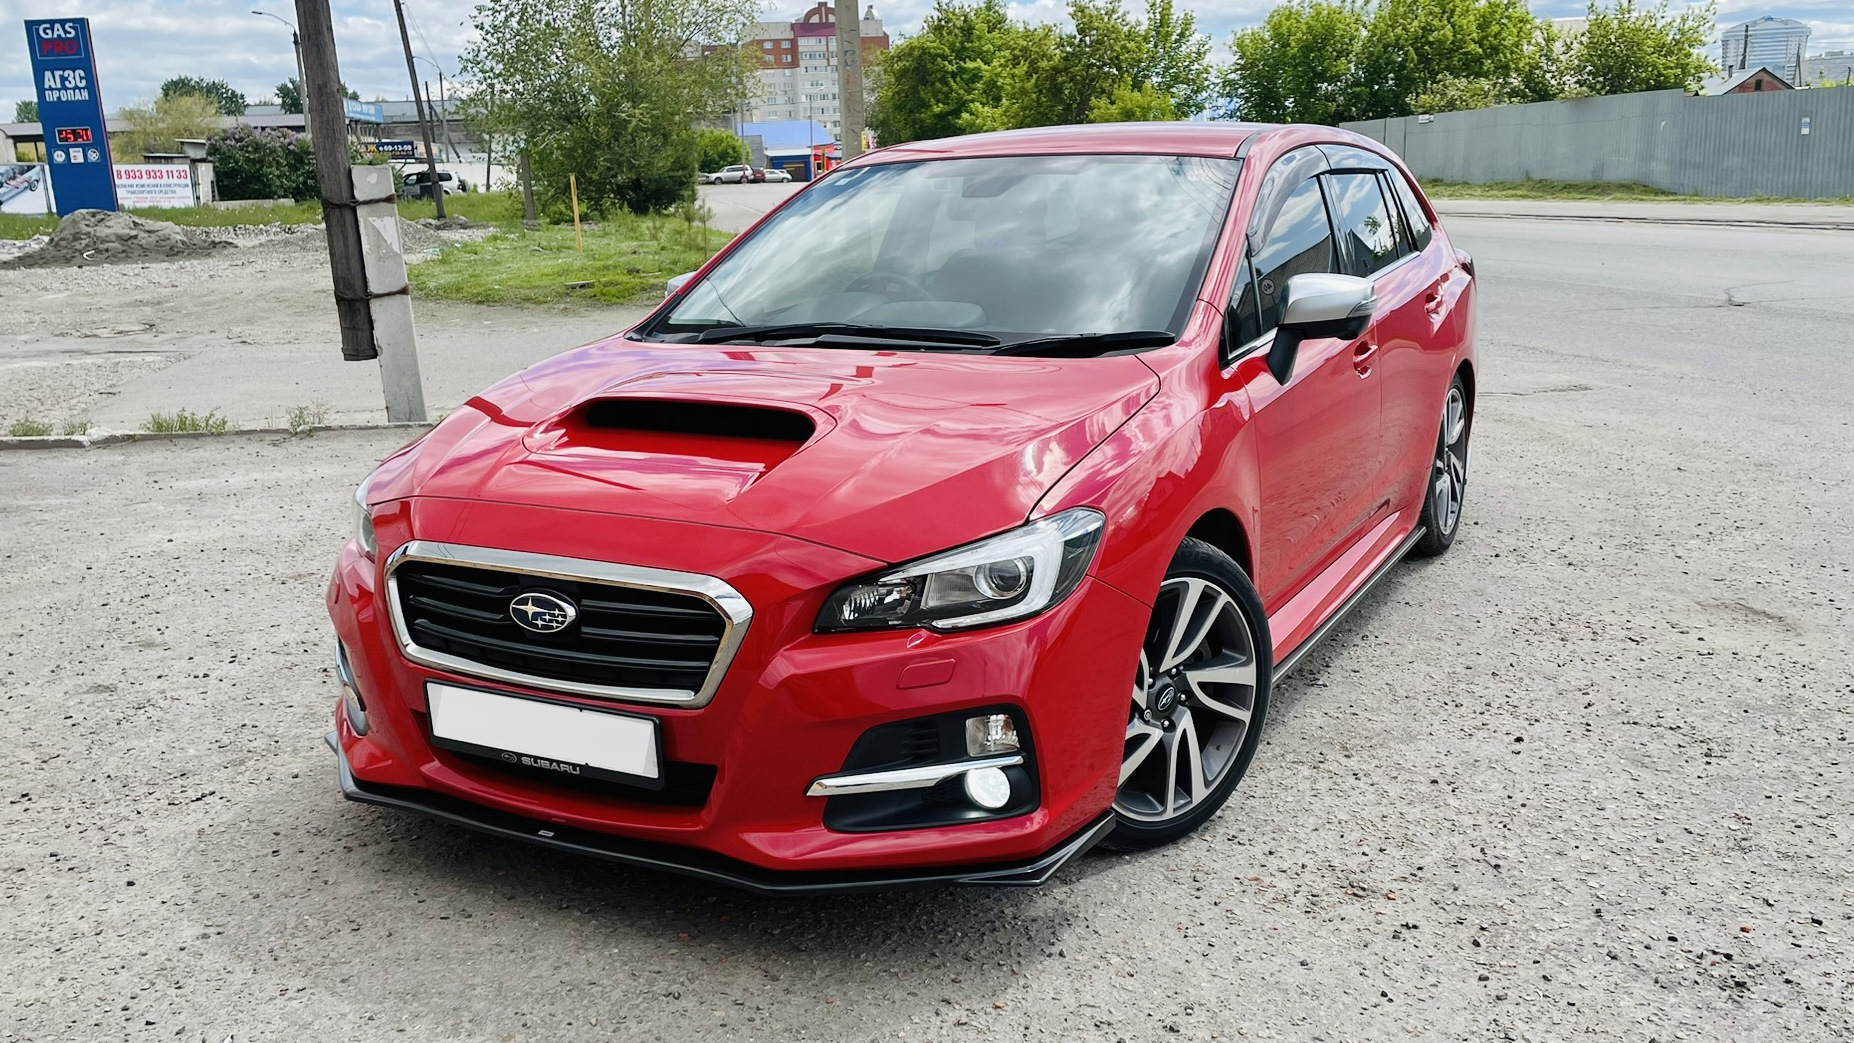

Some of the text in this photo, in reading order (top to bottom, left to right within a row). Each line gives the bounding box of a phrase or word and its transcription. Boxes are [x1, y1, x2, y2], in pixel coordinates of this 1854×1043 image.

[39, 22, 76, 38] GAS
[42, 40, 78, 55] PRO
[44, 69, 87, 88] АГЗС
[45, 89, 89, 101] ПРОПАН
[116, 169, 187, 179] 8 933 933 11 33
[521, 756, 581, 775] SUBARU
